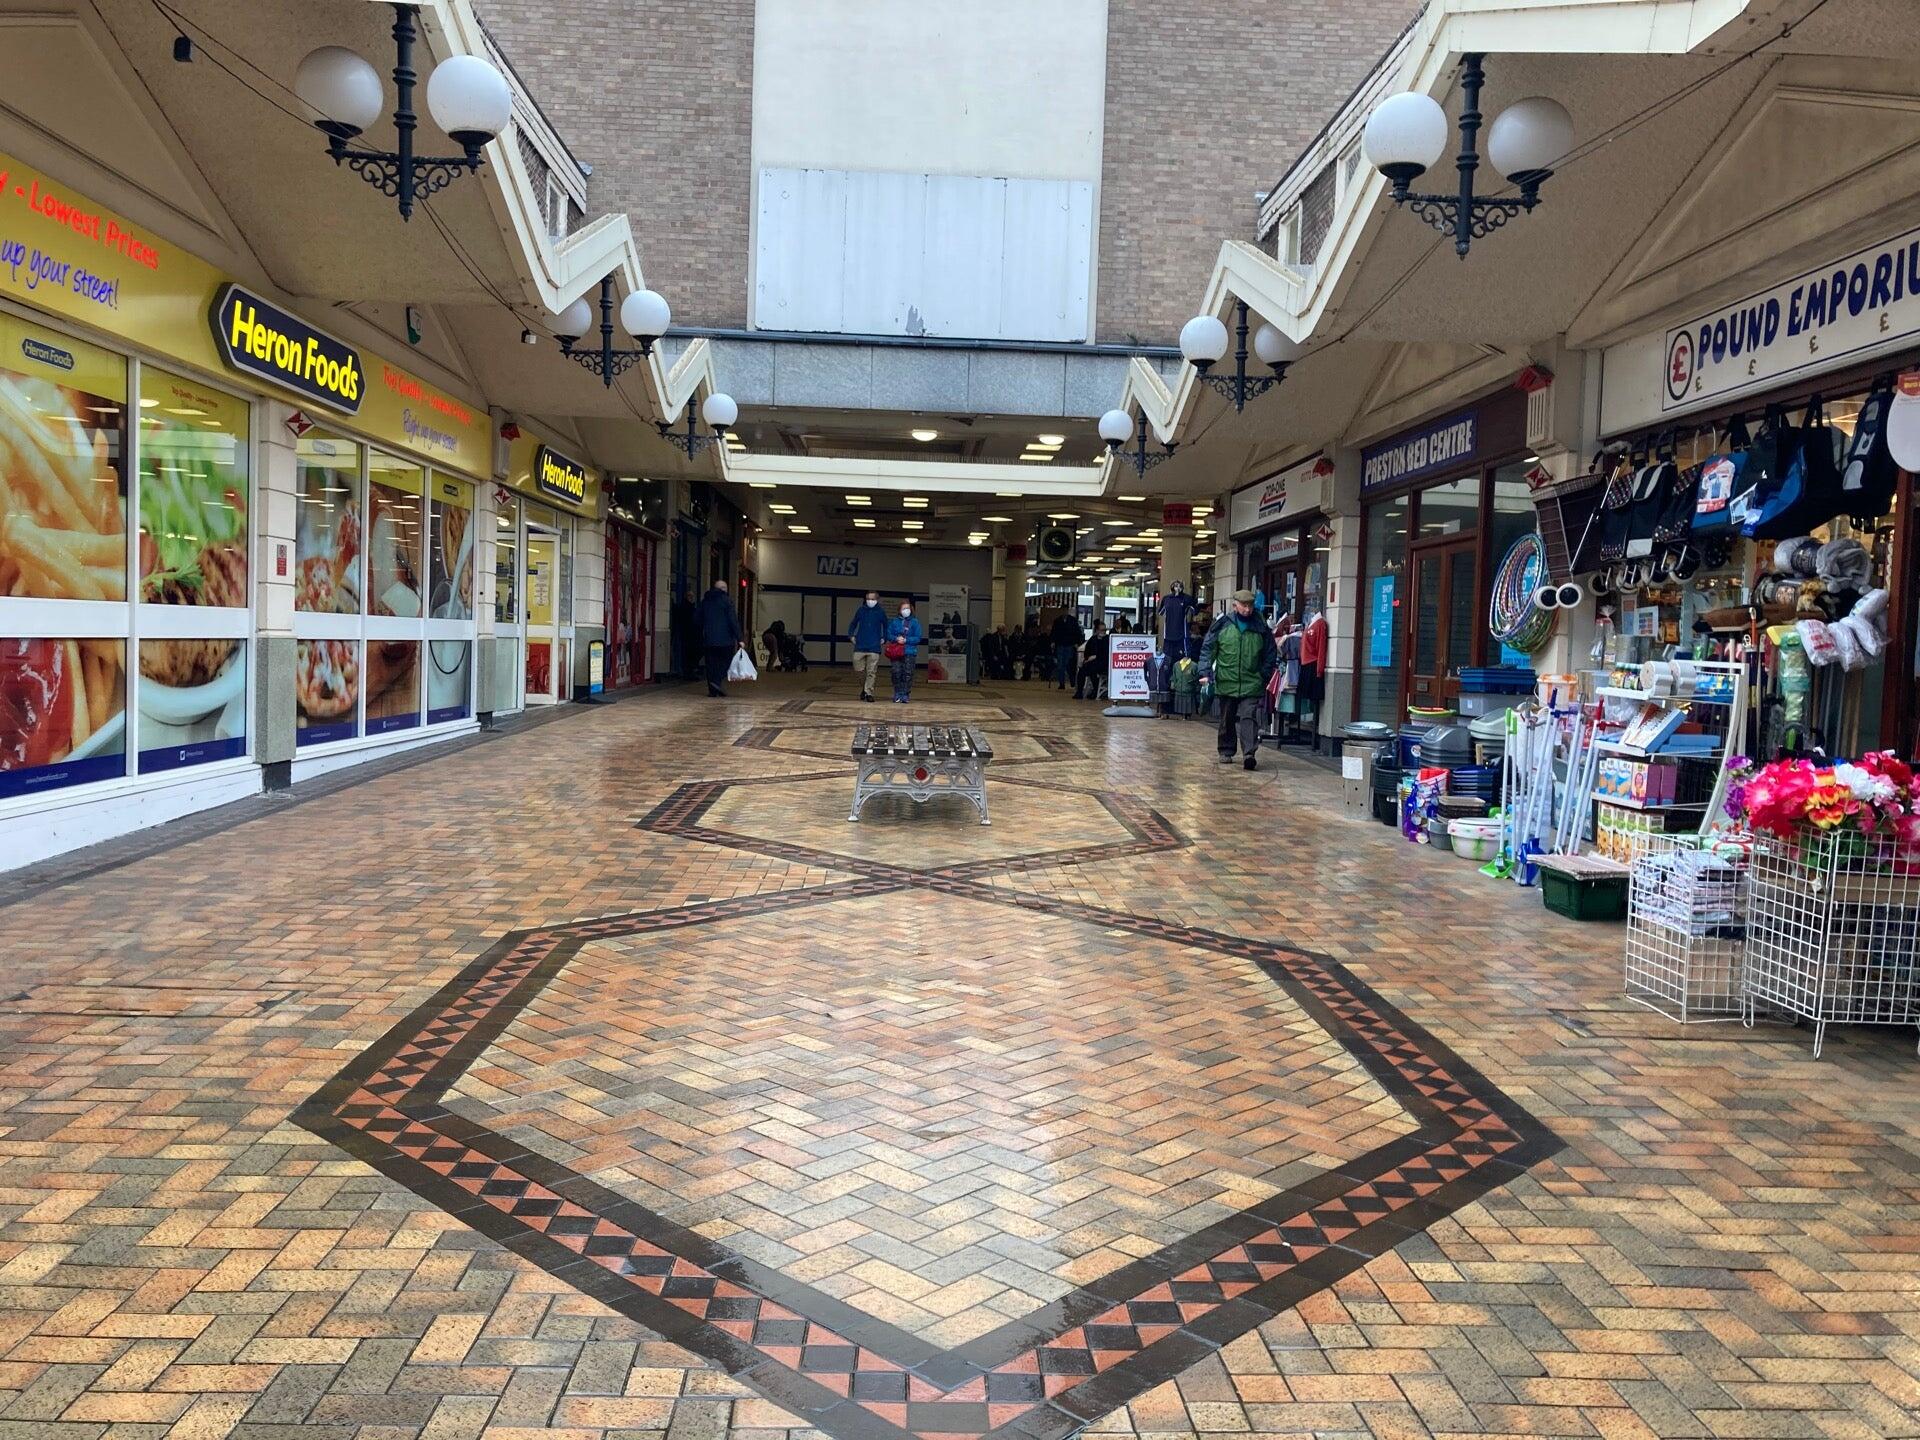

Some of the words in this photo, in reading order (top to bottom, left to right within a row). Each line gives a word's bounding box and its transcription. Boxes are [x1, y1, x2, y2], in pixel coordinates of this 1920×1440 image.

[29, 180, 101, 241] Lowest
[104, 220, 160, 270] Prices
[1, 239, 26, 282] up
[26, 250, 71, 290] your
[73, 268, 119, 310] street!
[25, 341, 49, 359] Heron
[50, 350, 72, 367] Foods
[231, 299, 302, 376] Heron
[304, 336, 359, 401] Foods
[1697, 298, 1780, 370] POUND
[542, 453, 566, 488] Heron
[565, 465, 584, 497] Foods
[1365, 445, 1407, 486] PRESTON
[1407, 437, 1428, 472] BED
[1429, 420, 1473, 464] CENTRE
[818, 556, 857, 575] NHS
